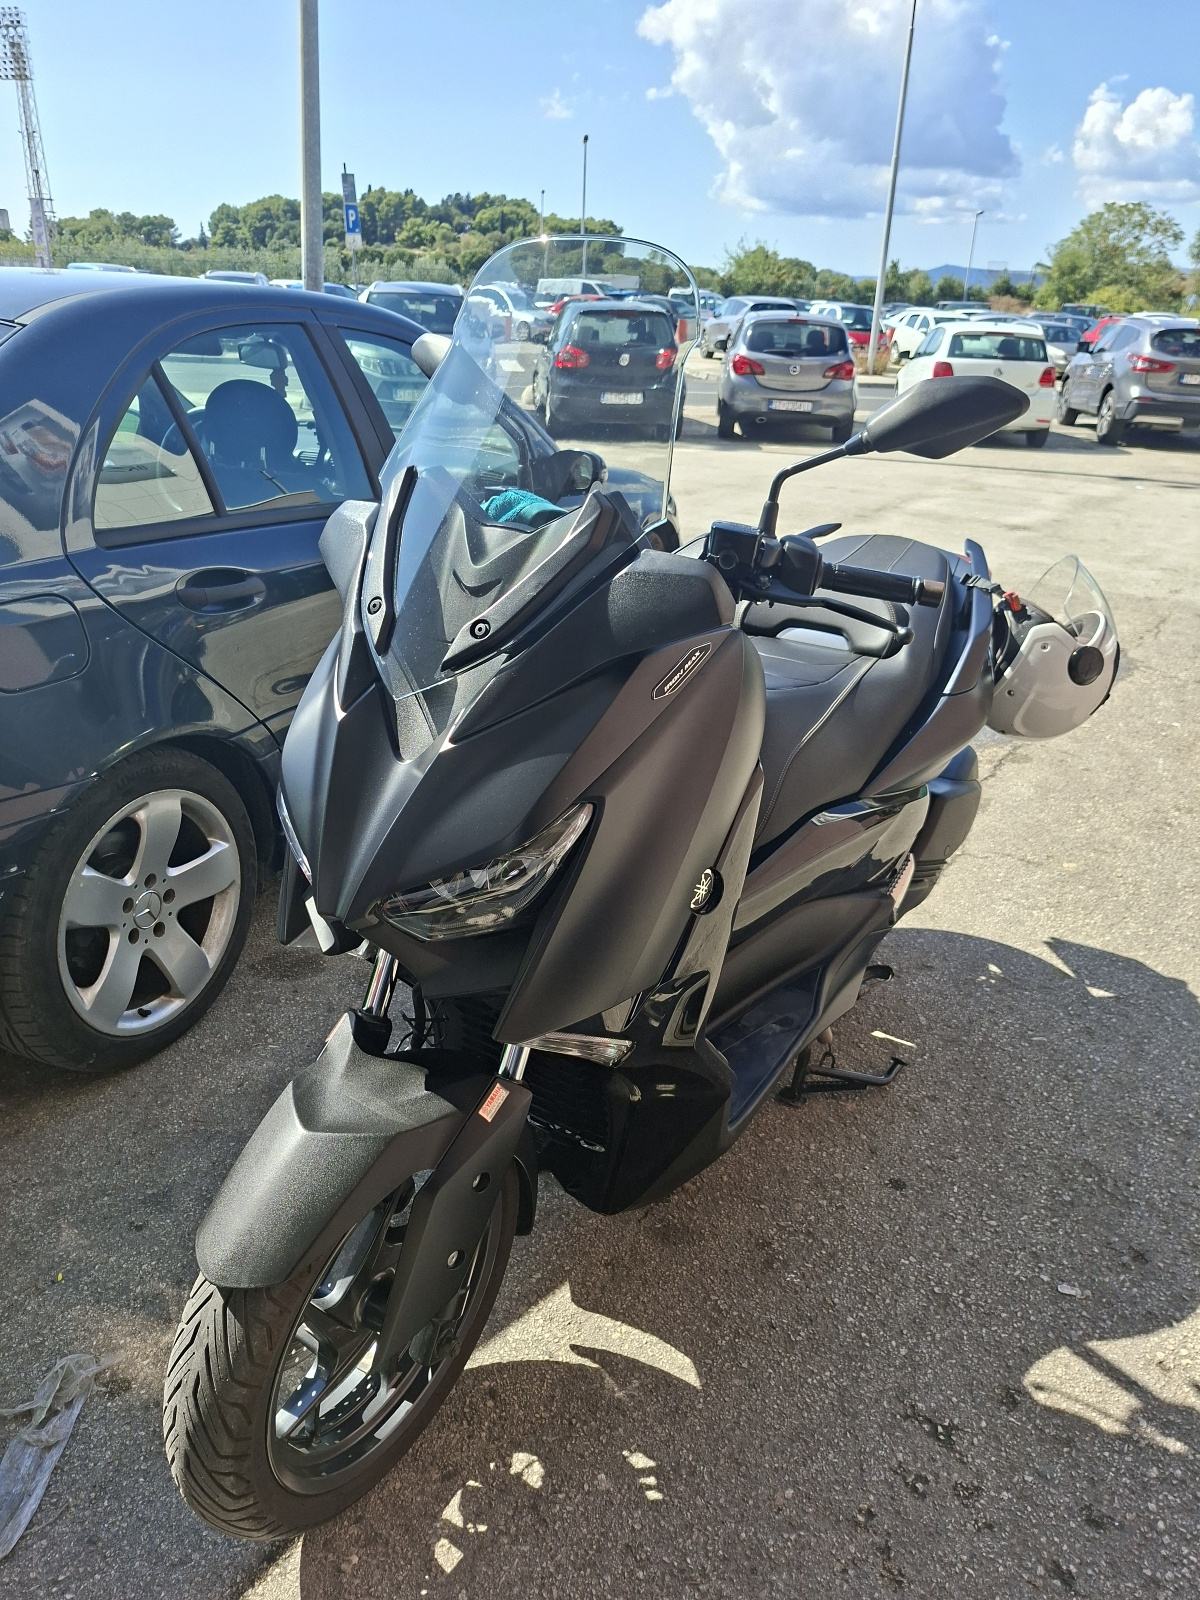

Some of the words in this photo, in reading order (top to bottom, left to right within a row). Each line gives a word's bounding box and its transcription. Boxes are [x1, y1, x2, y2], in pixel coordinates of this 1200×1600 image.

[347, 209, 357, 229] P
[664, 668, 684, 693] IRON
[684, 649, 701, 671] MAX
[485, 1086, 503, 1108] YAMAHA
